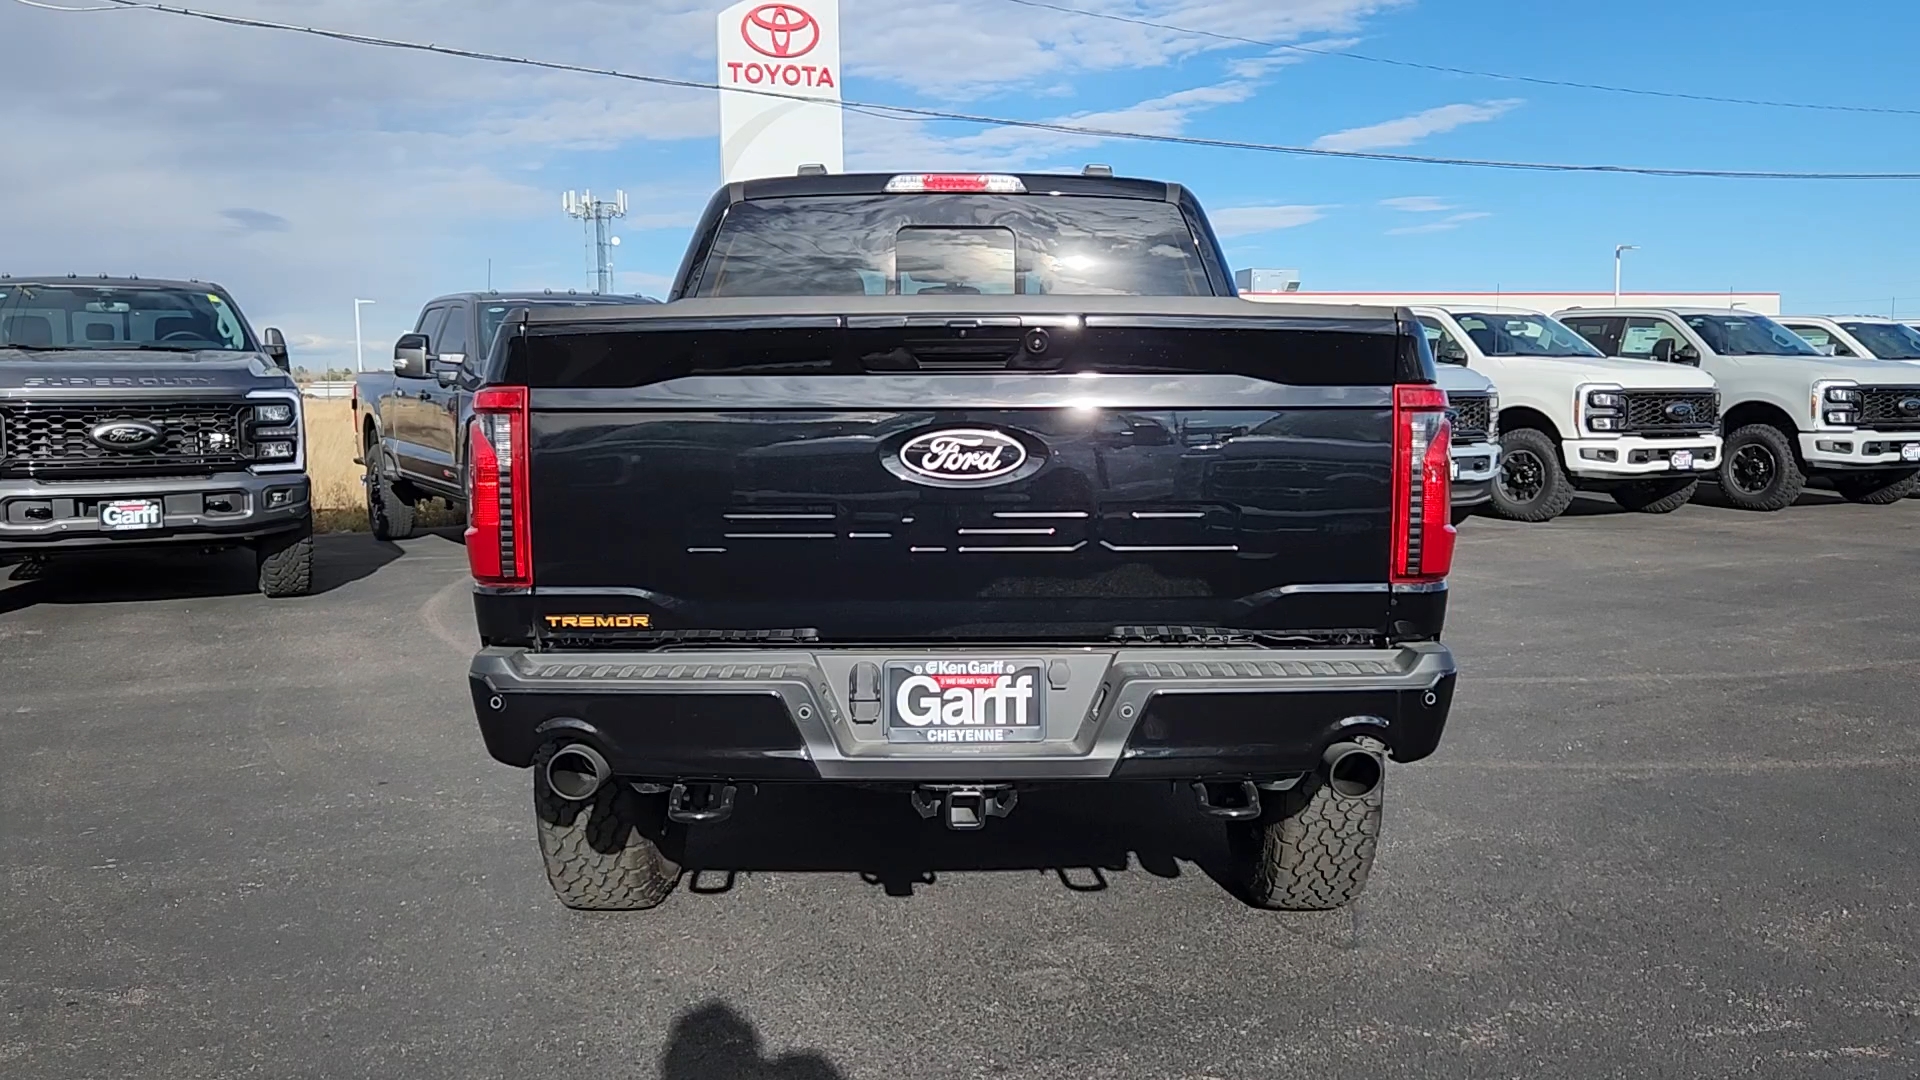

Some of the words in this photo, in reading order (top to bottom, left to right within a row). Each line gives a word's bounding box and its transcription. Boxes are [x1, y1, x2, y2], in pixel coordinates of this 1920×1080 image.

[727, 62, 834, 88] TOYOTA
[25, 377, 132, 387] SUPER
[922, 437, 1004, 471] Ford
[103, 505, 159, 525] Garff
[545, 615, 649, 627] TREMOR
[938, 661, 967, 674] Ken
[967, 660, 1004, 675] Garff
[896, 675, 1033, 726] Garff
[927, 729, 1004, 742] CHEYENNE
